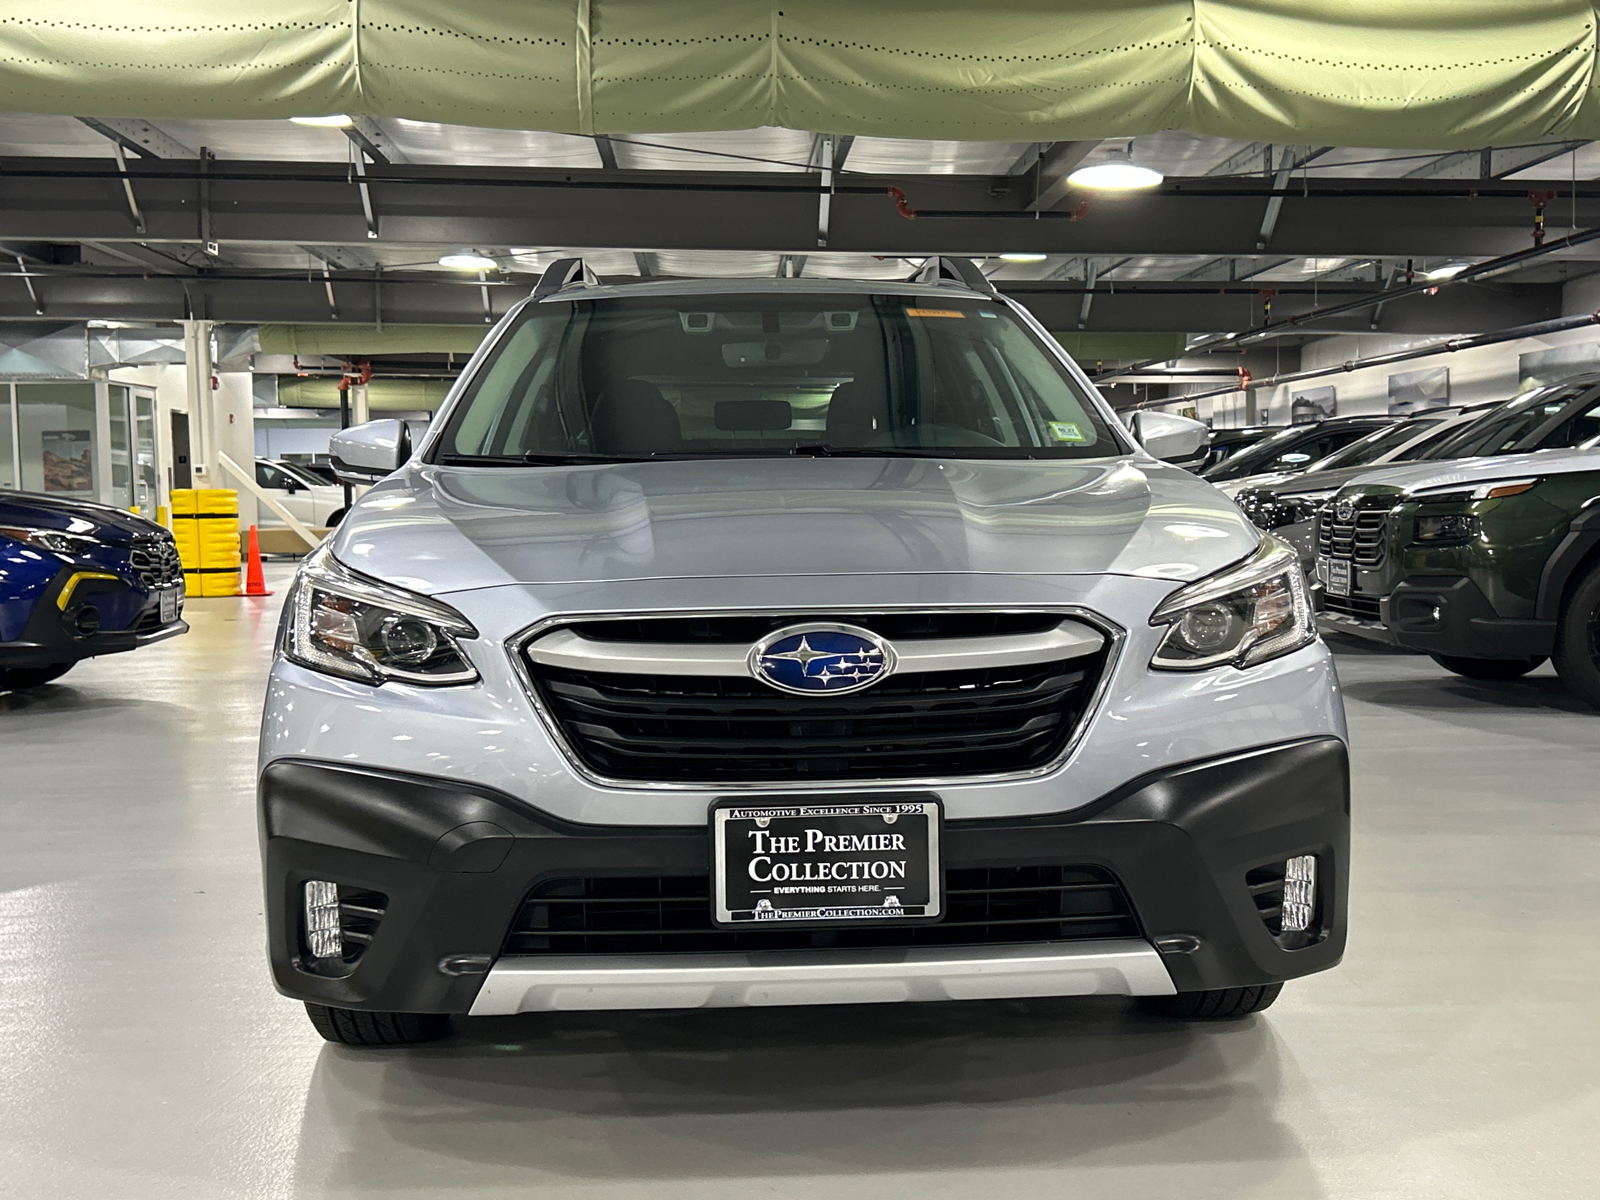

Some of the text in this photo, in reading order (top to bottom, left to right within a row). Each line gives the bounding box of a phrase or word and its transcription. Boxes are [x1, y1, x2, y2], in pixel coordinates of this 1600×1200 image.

[731, 804, 922, 818] AUTOMOTIVE EXCELLENCE SINCE 1995
[748, 829, 906, 854] THE PREMIER
[748, 856, 907, 882] COLLECTION
[773, 886, 826, 894] EVERYTHING
[827, 885, 857, 893] STARTS
